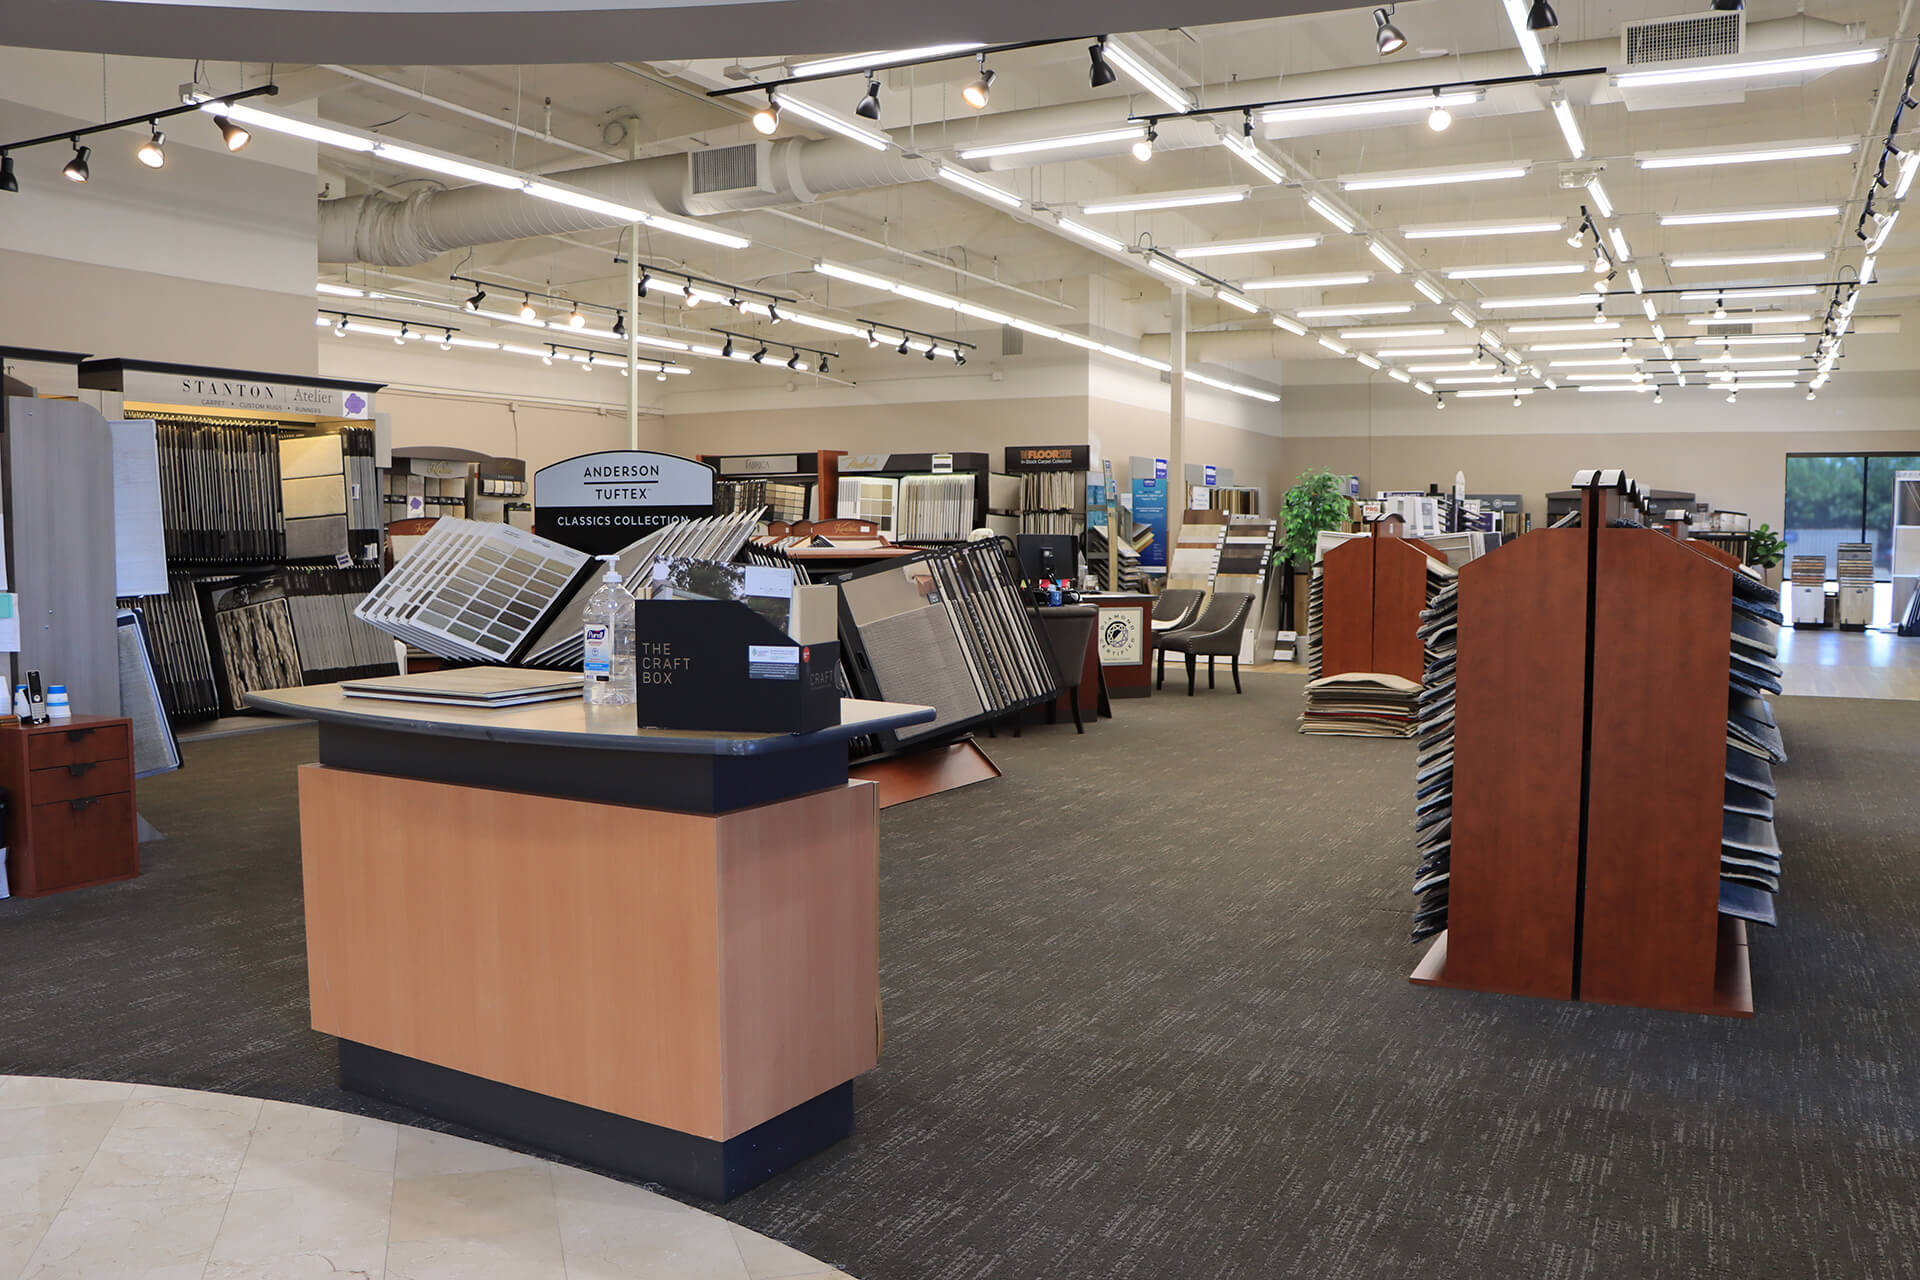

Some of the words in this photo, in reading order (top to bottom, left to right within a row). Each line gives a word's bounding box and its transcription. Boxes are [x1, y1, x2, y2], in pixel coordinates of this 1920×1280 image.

[182, 379, 274, 400] STANTON
[294, 387, 334, 405] Atelier
[201, 399, 225, 408] CARPET
[239, 402, 265, 411] CUSTOM
[295, 406, 321, 414] RUNNERS
[583, 465, 660, 478] ANDERSON
[595, 488, 648, 500] TUFTEX
[557, 516, 611, 526] CLASSICS
[614, 515, 689, 526] COLLECTION
[642, 642, 672, 655] THE
[642, 657, 691, 670] CRAFT
[642, 671, 673, 685] BOX
